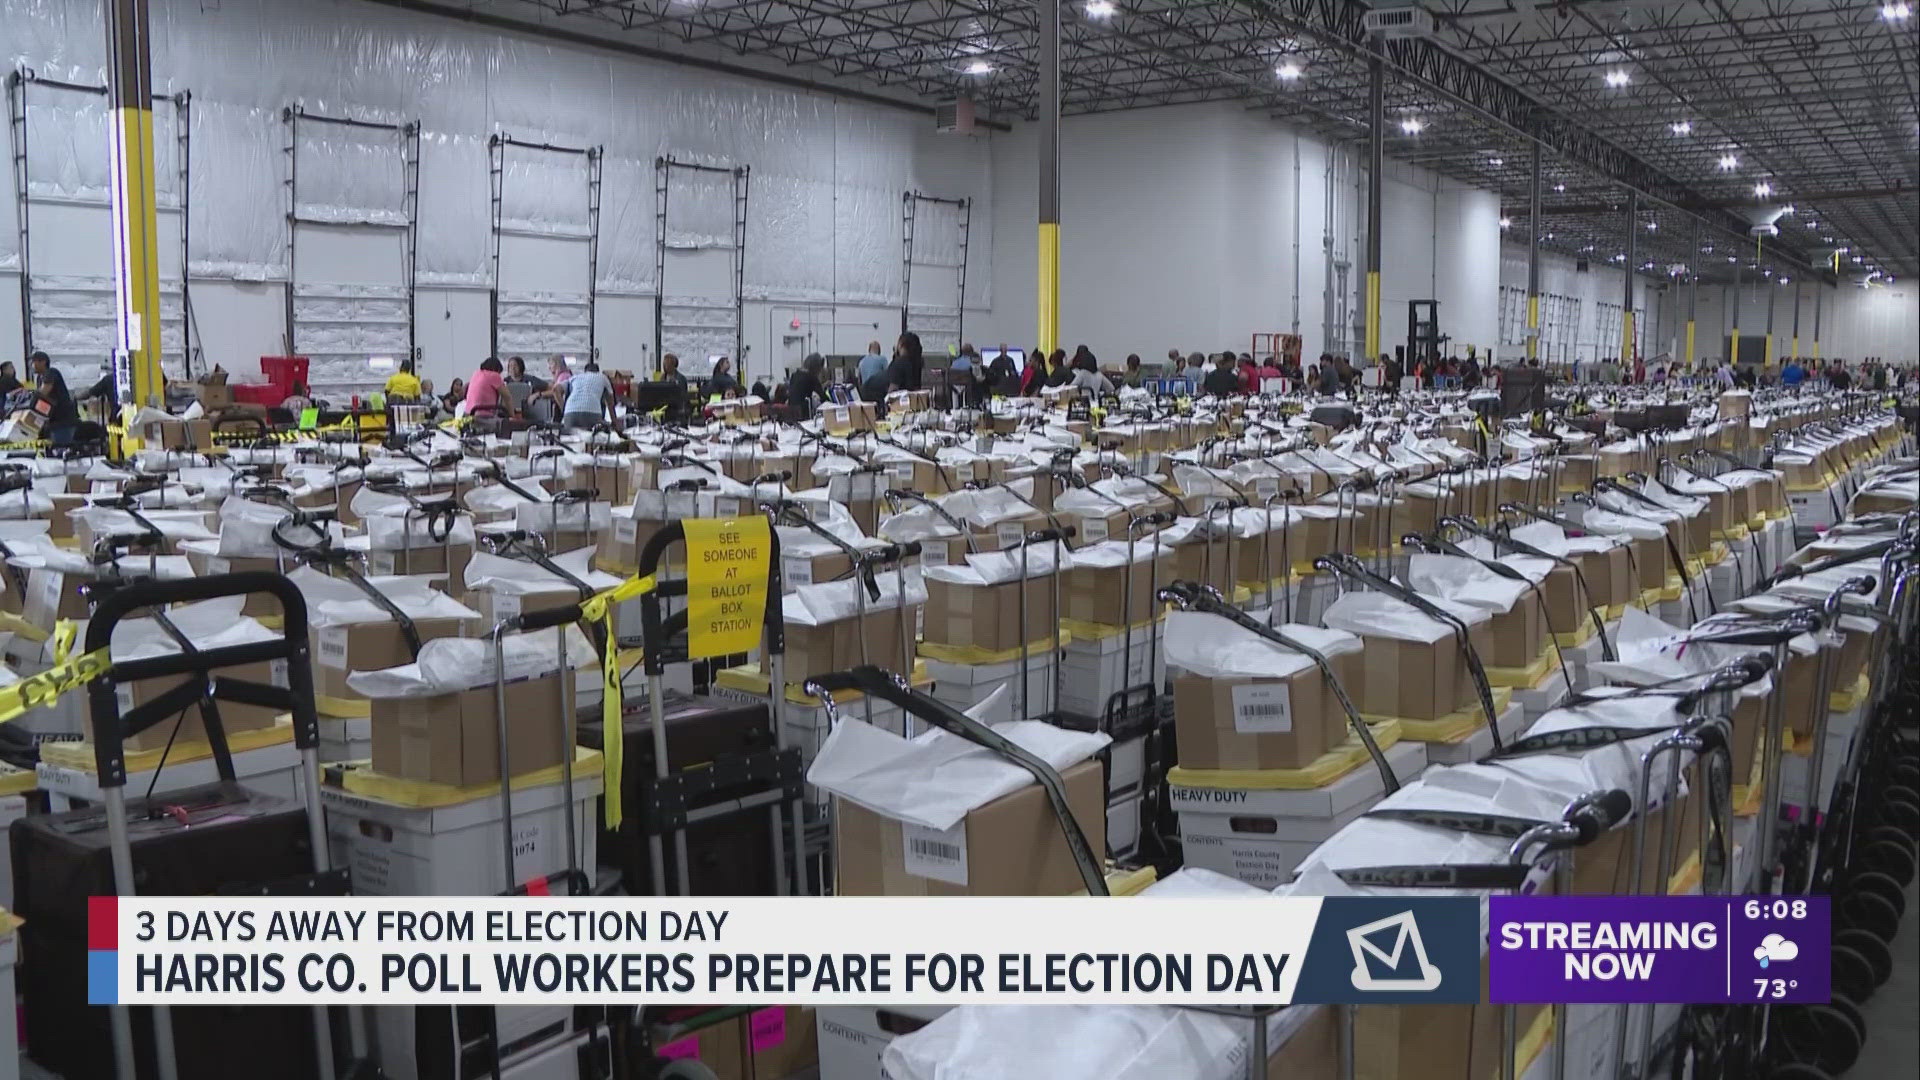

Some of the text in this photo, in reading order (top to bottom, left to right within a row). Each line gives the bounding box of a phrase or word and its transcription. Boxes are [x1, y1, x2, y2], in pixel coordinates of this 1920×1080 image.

[719, 533, 740, 544] SEE
[703, 548, 757, 562] SOMEONE
[725, 568, 738, 579] AT
[711, 584, 751, 598] BALLOT
[721, 602, 743, 614] BOX
[711, 618, 751, 633] STATION
[1172, 789, 1248, 803] HEAVY DUTY
[1232, 849, 1280, 860] Harris County
[1236, 861, 1279, 871] Election Day
[1264, 872, 1278, 881] Box
